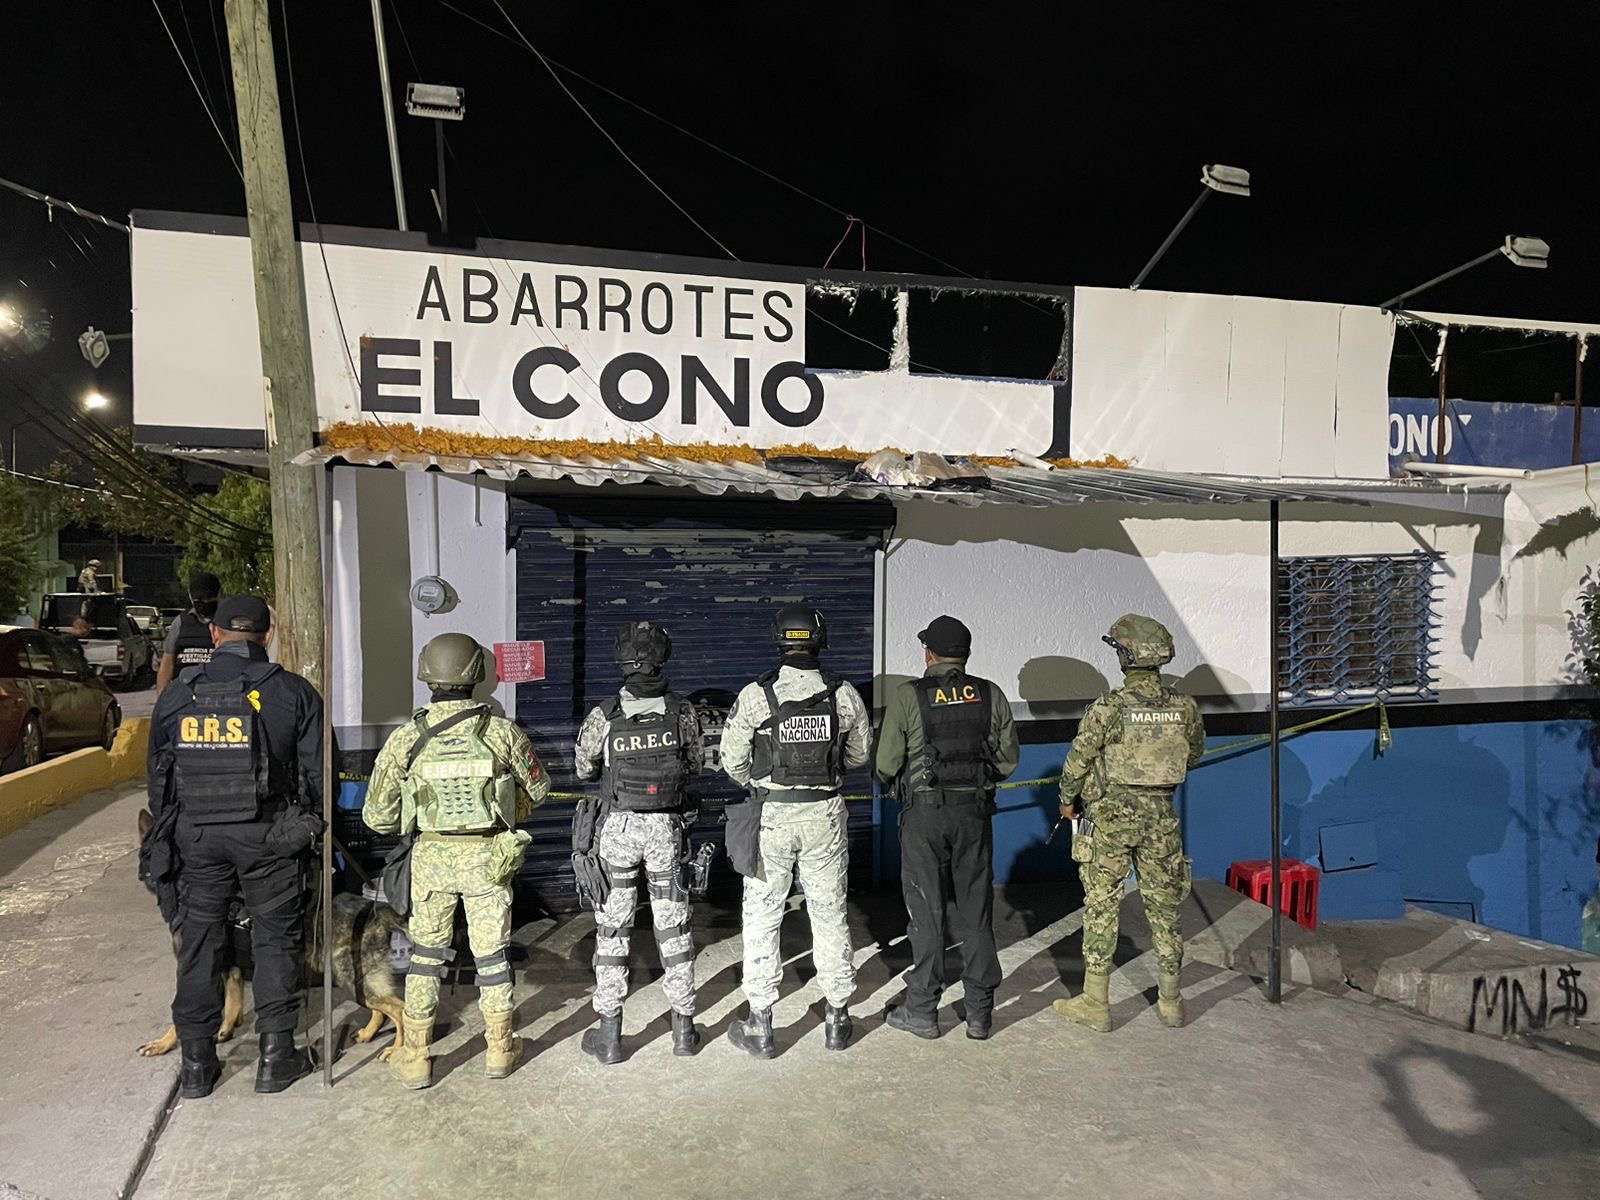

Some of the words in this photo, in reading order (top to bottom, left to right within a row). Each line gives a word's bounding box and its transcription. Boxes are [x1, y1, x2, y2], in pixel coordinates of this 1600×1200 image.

[416, 265, 794, 343] ABARROTES
[360, 336, 480, 416] EL
[512, 346, 825, 428] CONO
[935, 685, 975, 703] A.I.C
[783, 716, 827, 730] GUARDIA
[1131, 712, 1181, 722] MARINA
[181, 717, 248, 742] G.R.S.
[780, 729, 830, 741] NACIONAL
[613, 732, 677, 752] G.R.E.C.
